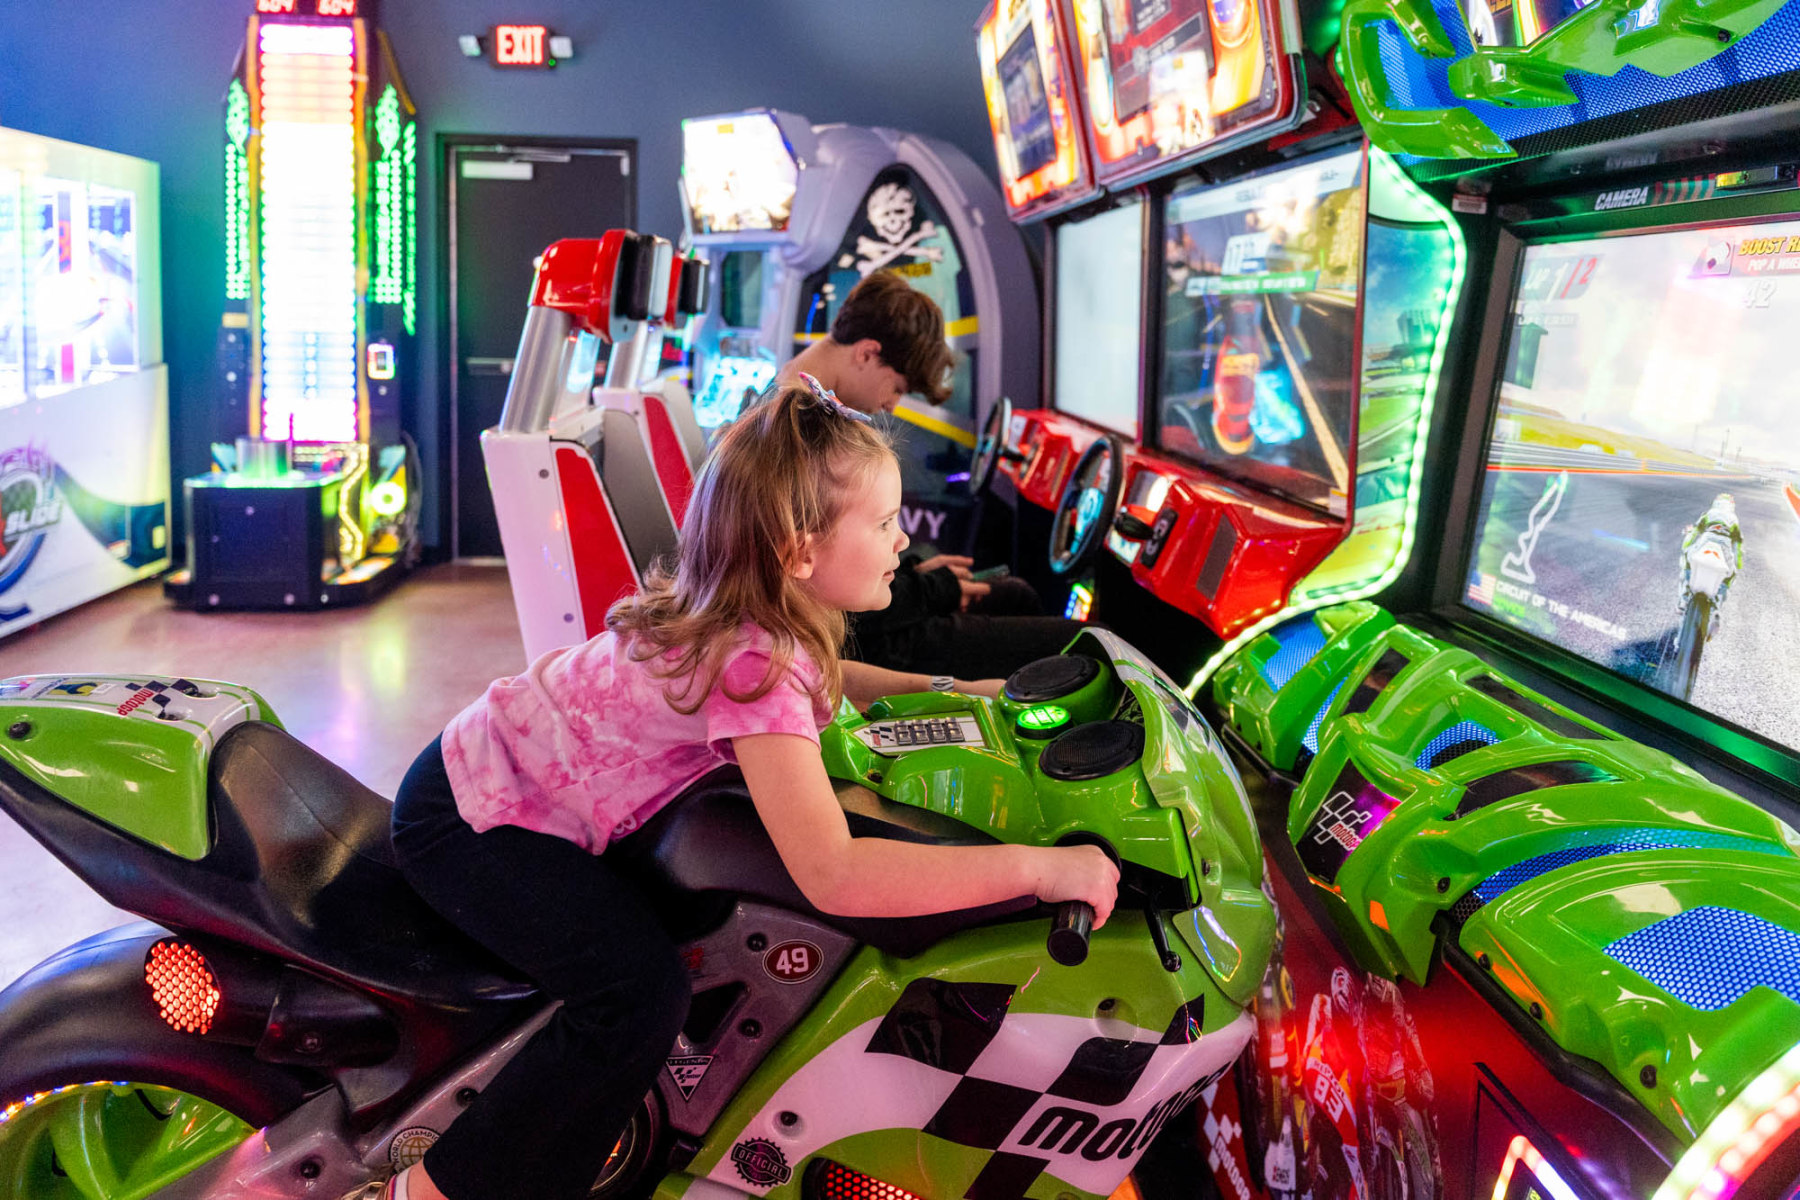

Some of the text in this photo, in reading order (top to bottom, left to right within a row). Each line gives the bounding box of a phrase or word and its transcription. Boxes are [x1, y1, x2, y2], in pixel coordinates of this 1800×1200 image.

[497, 25, 546, 65] EXIT
[1594, 186, 1649, 211] CAMERA
[1738, 236, 1787, 256] BOOST
[898, 505, 946, 539] VY
[1532, 593, 1547, 608] OF
[1548, 599, 1570, 619] THE
[776, 947, 809, 975] 49
[1314, 1073, 1344, 1123] 93
[738, 1149, 783, 1178] OFFICIAL
